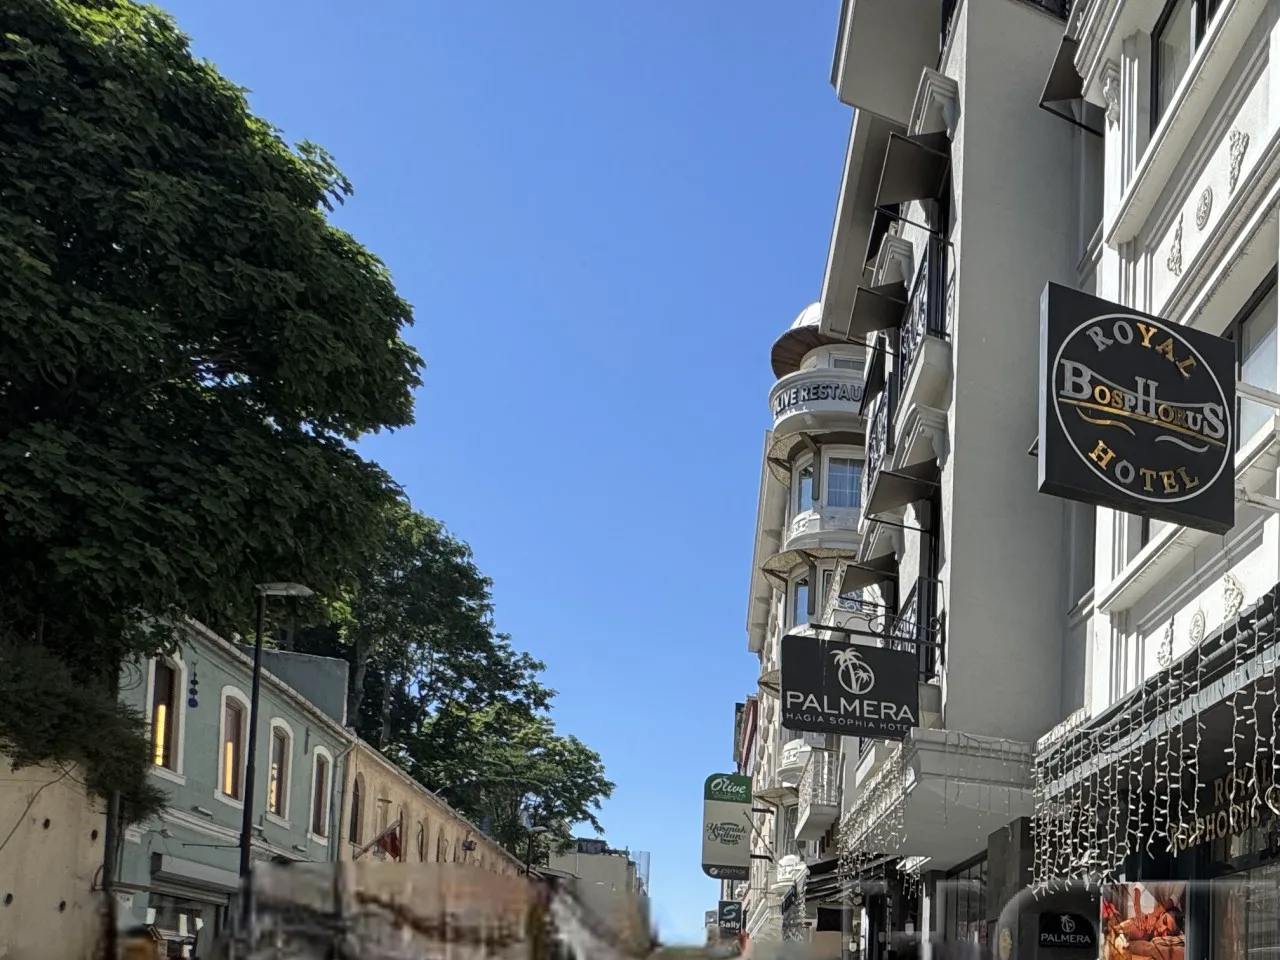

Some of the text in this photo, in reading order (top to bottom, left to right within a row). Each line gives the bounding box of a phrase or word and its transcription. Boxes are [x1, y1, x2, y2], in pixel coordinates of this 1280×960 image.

[1085, 320, 1198, 381] ROYAL
[775, 383, 862, 414] LIVE RESTAU
[1088, 440, 1199, 495] HOTEL
[786, 691, 915, 723] PALMERA
[786, 712, 910, 732] HAGIA SOPHIA HOTE
[711, 776, 747, 794] Olive
[719, 920, 741, 929] Sally
[1040, 933, 1091, 943] PALMERA
